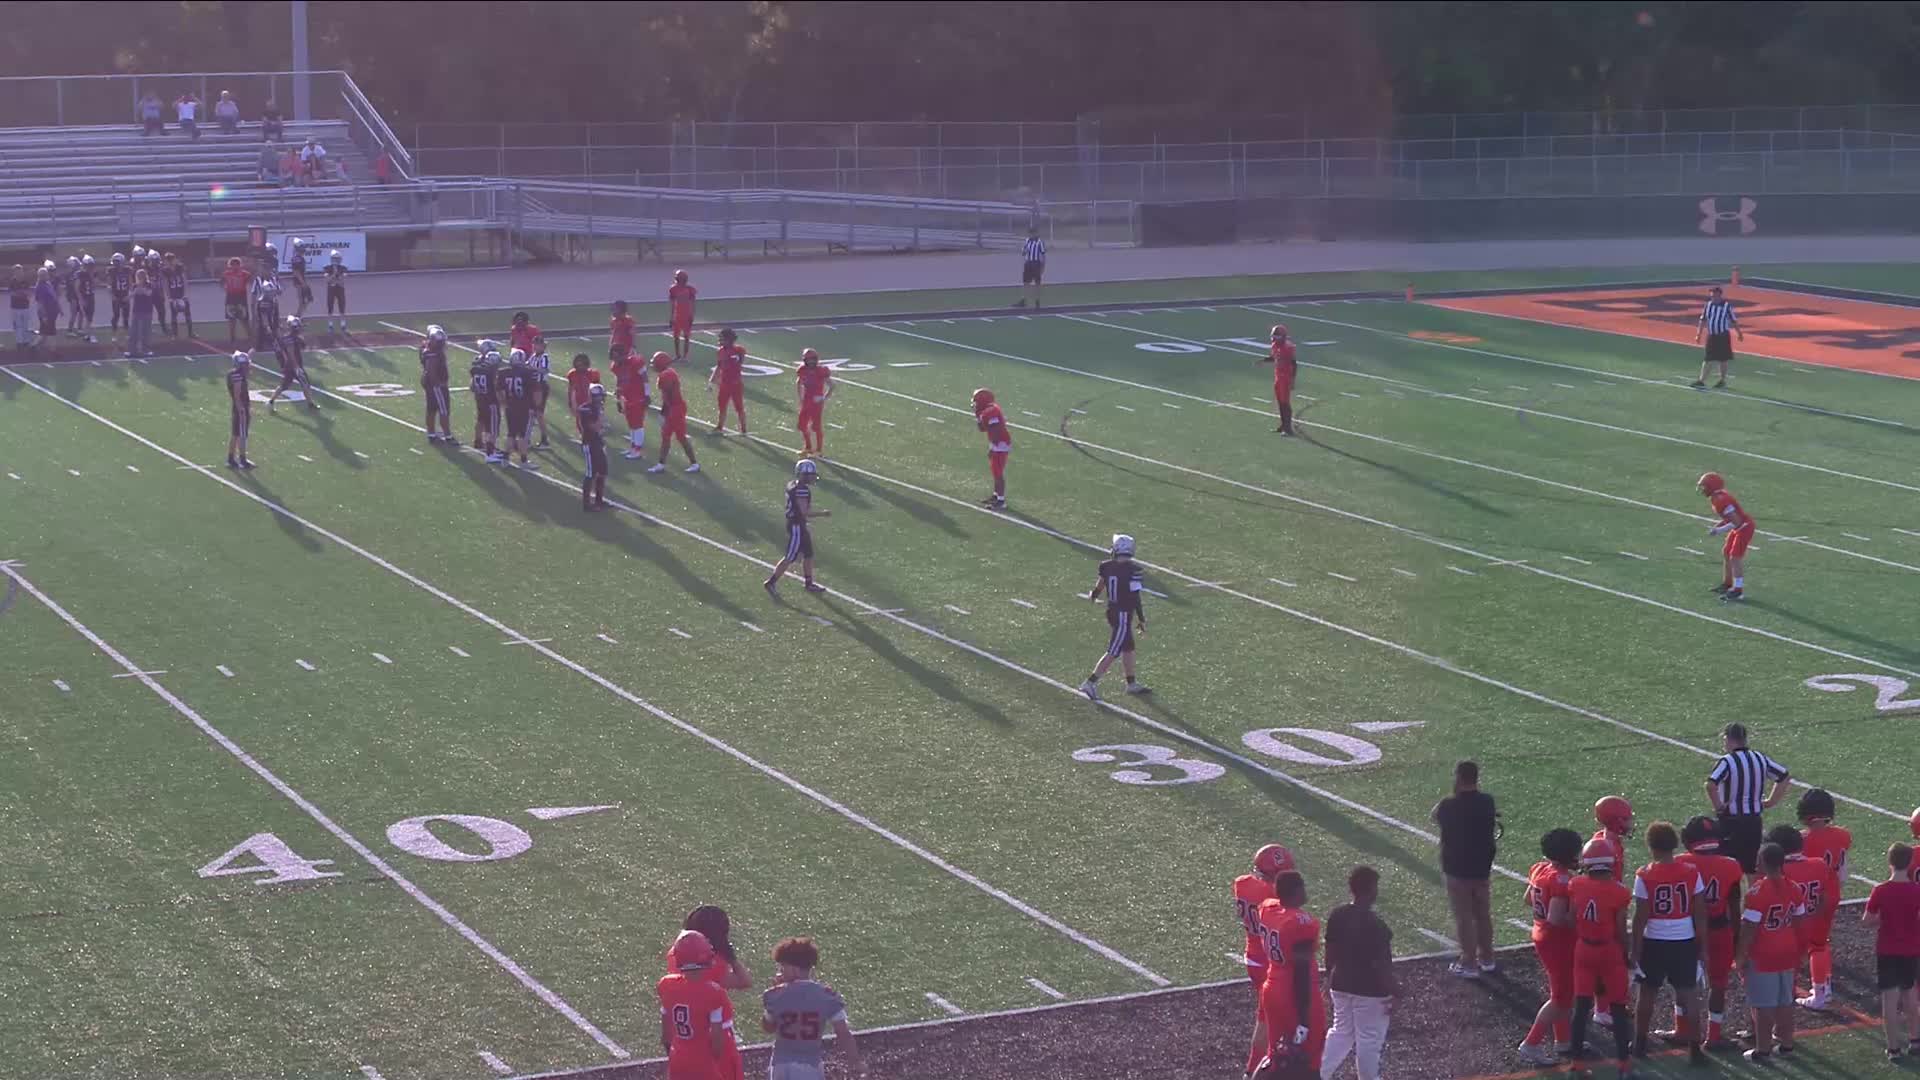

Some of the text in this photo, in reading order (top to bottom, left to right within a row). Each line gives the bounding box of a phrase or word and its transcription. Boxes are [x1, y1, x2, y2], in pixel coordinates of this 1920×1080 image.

[505, 377, 524, 399] 76
[1654, 881, 1689, 915] 81
[672, 1003, 694, 1040] 8
[779, 1011, 820, 1040] 25
